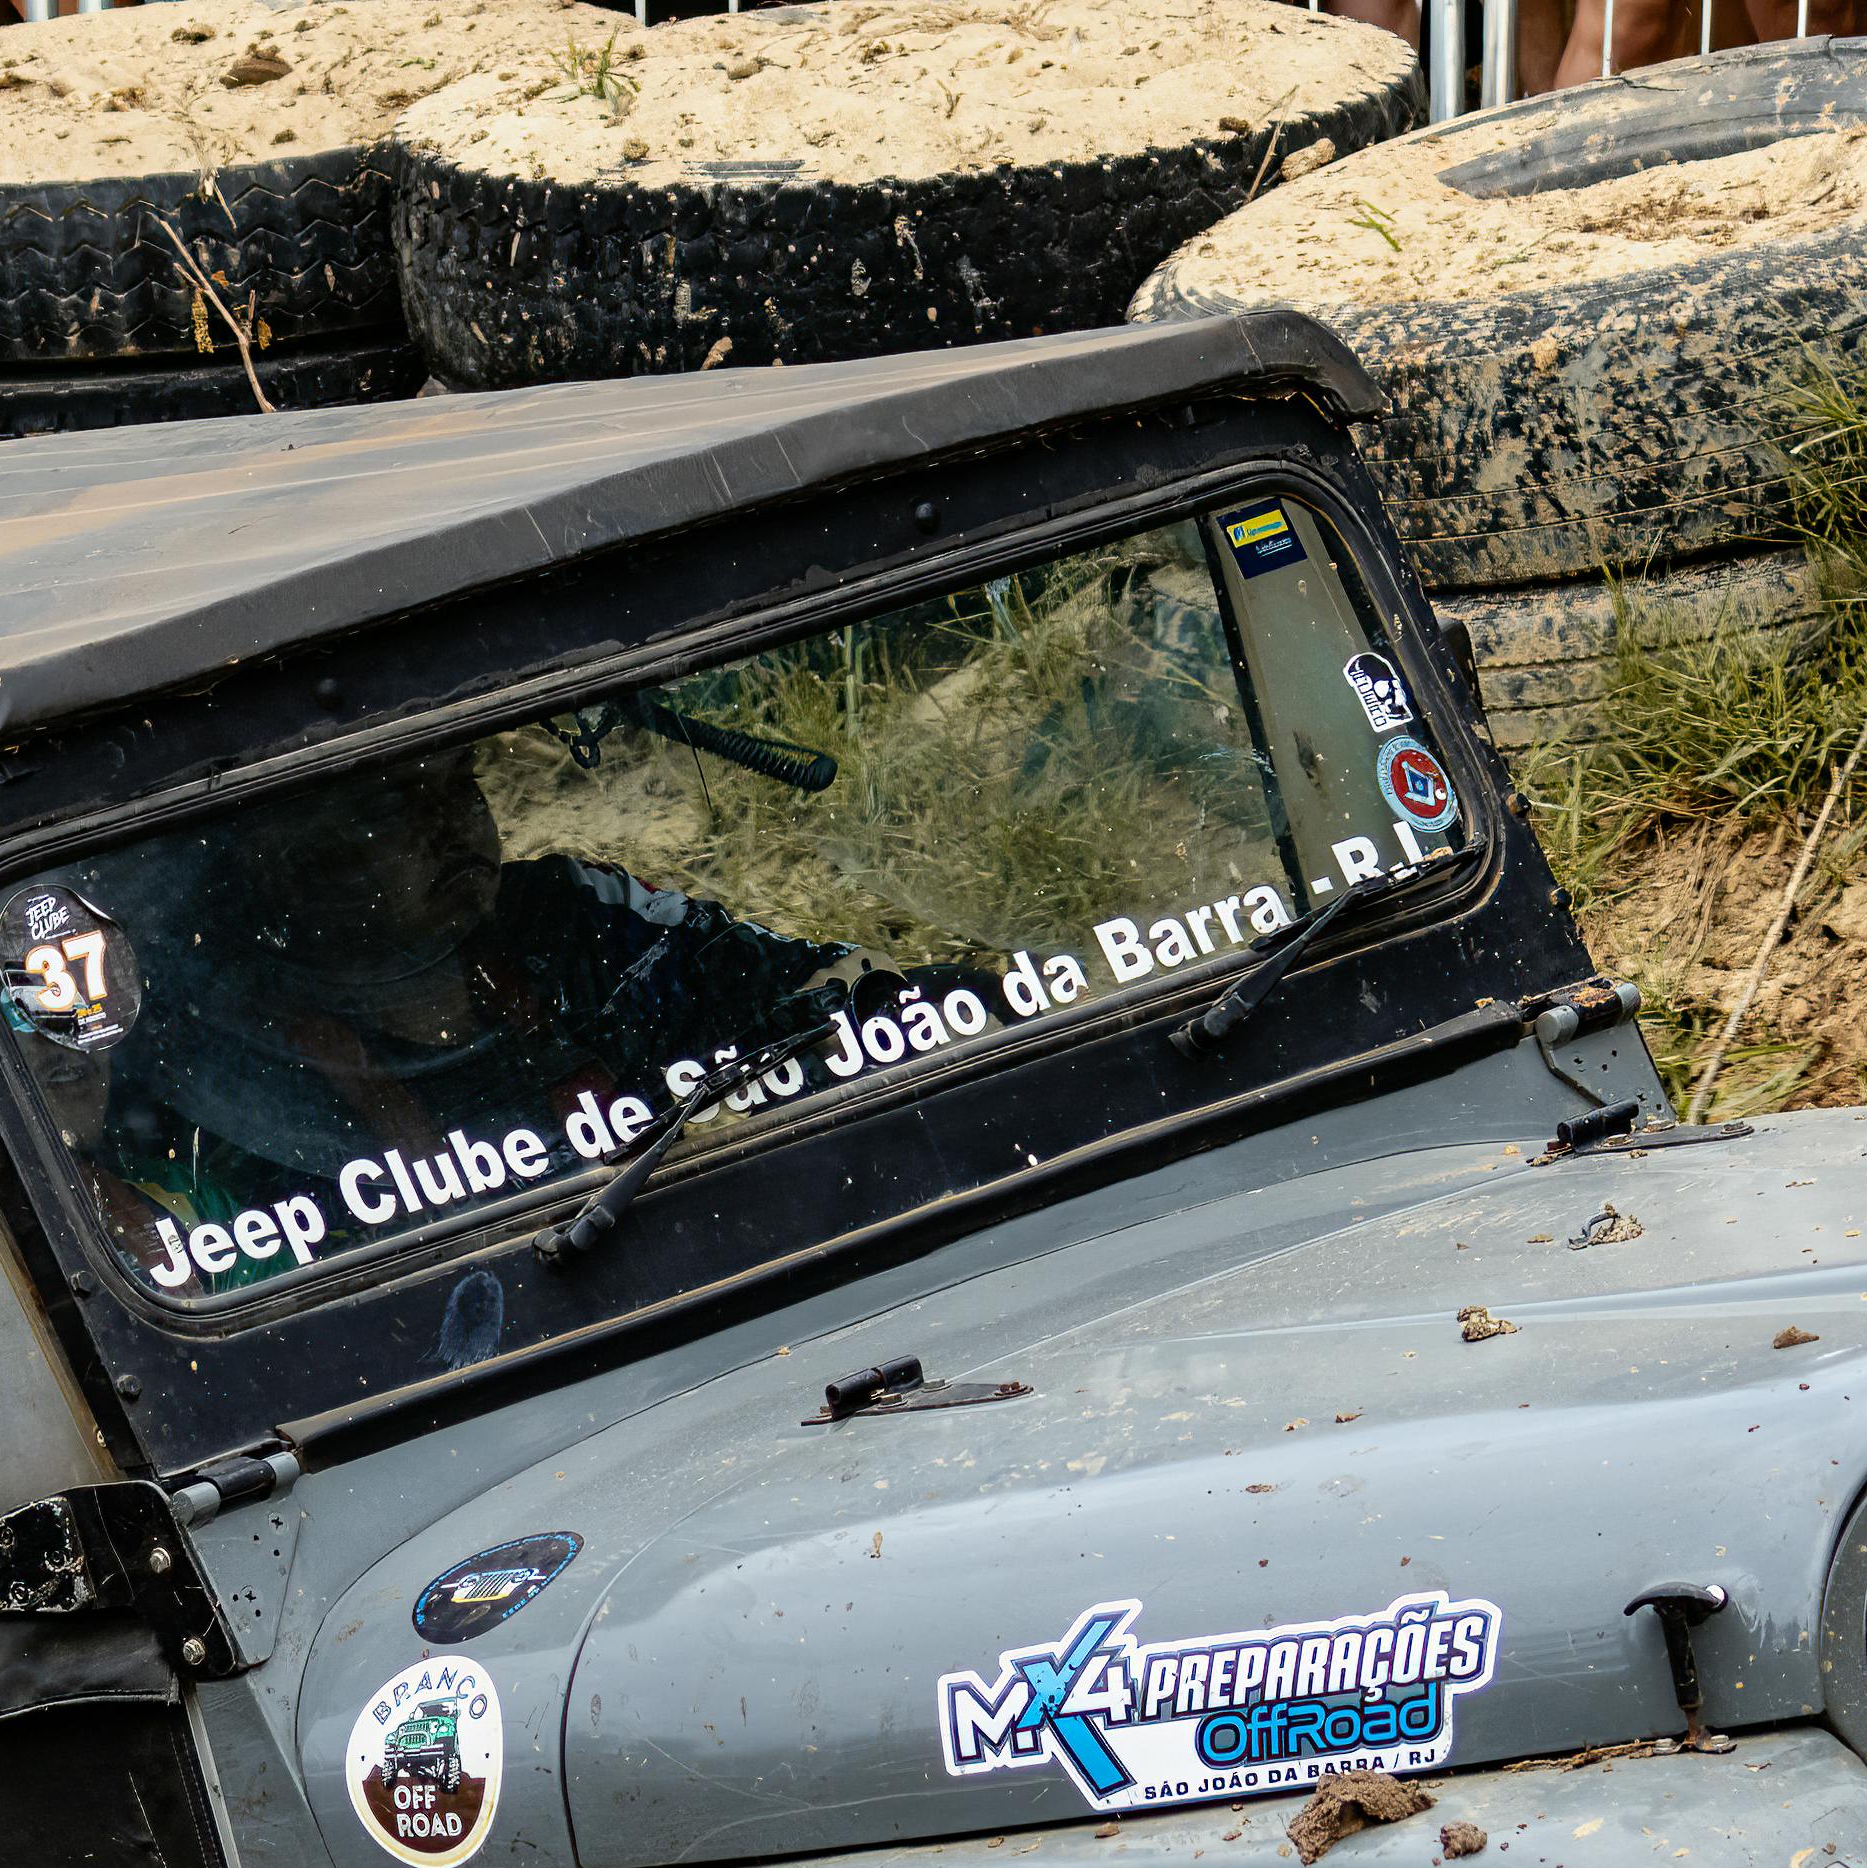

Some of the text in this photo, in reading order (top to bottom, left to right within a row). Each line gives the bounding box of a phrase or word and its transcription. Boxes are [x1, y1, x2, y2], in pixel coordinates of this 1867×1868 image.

[25, 896, 57, 926] JEEP
[32, 905, 70, 940] CLUBE
[24, 929, 108, 1012] 37
[147, 1191, 326, 1288] Jeep
[338, 1130, 551, 1225] Clube
[564, 1090, 654, 1159] de
[825, 986, 987, 1078] João
[1001, 950, 1090, 1019] da
[1093, 885, 1296, 984] Barra
[1142, 1602, 1491, 1720] PREPARAÇÕES
[372, 1667, 488, 1725] BRANCO
[393, 1784, 436, 1810] OFF
[1144, 1782, 1189, 1800] SÃO
[1198, 1770, 1258, 1794] JOÃO
[1268, 1767, 1298, 1783] DA
[1409, 1749, 1436, 1766] RJ
[396, 1812, 463, 1838] ROAD
